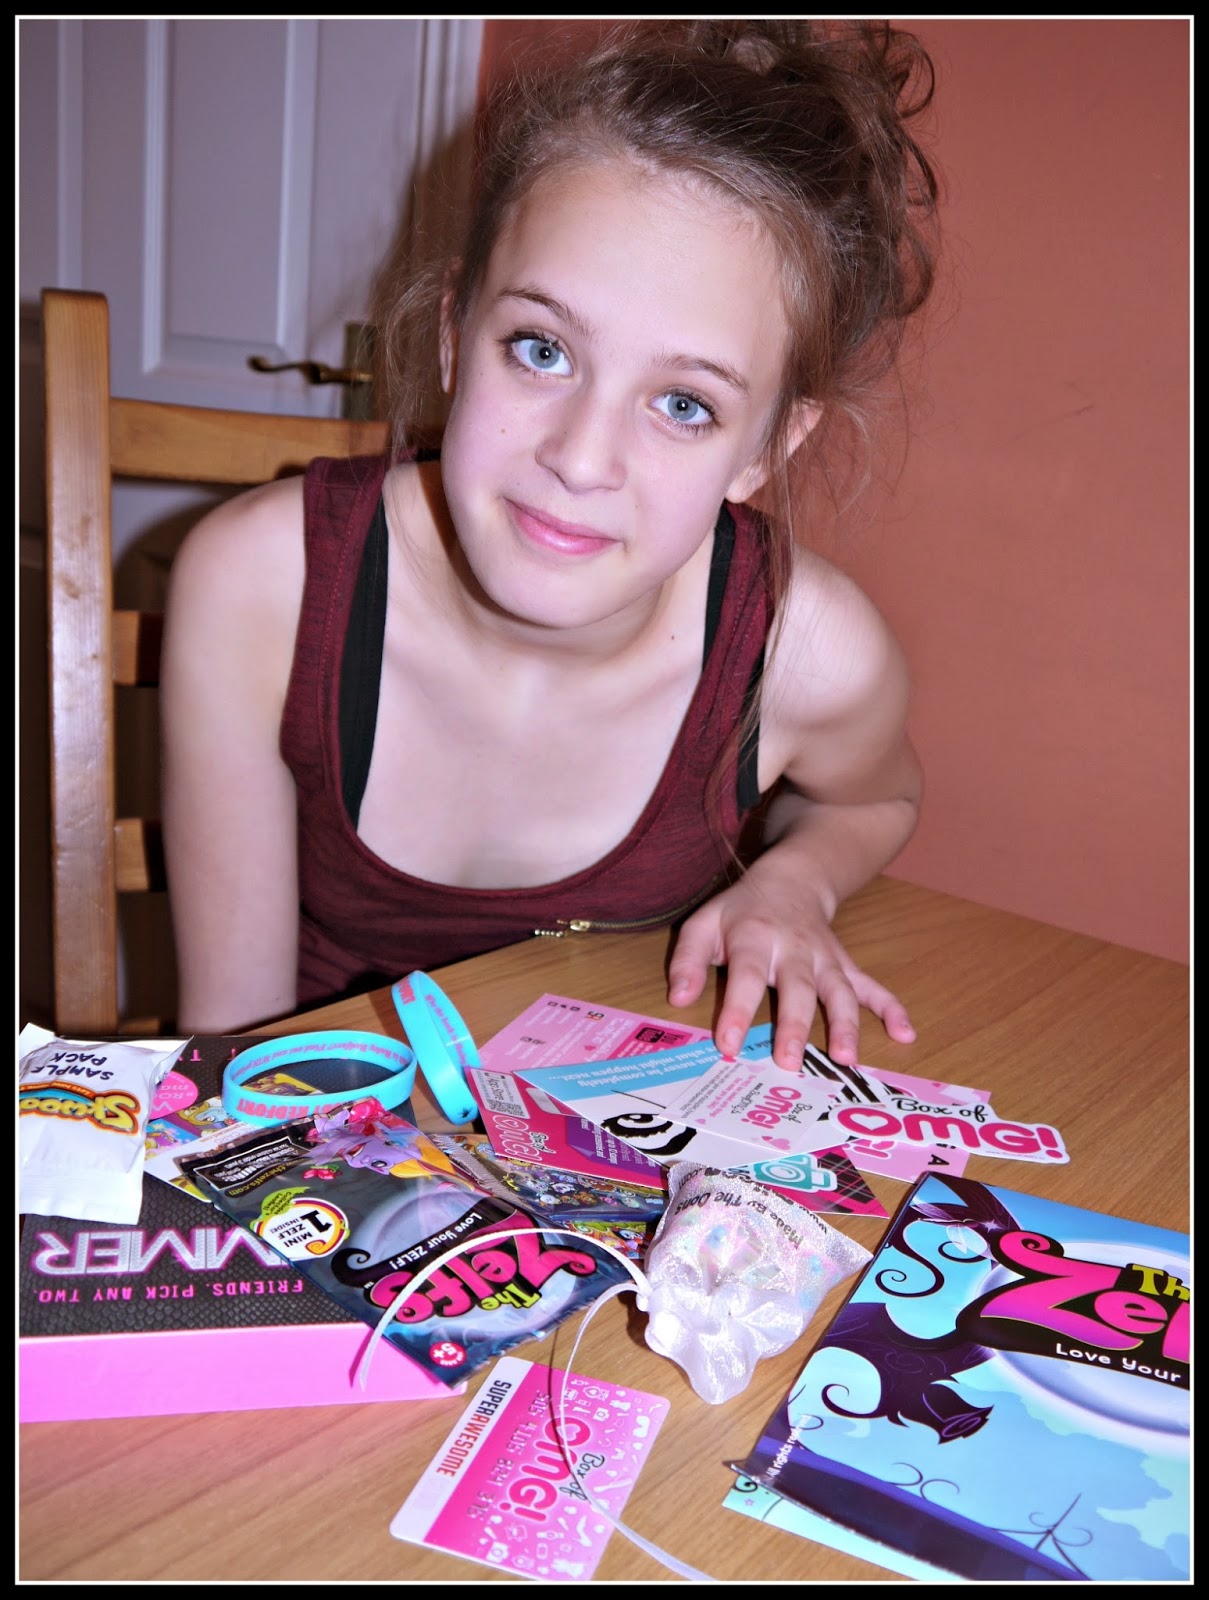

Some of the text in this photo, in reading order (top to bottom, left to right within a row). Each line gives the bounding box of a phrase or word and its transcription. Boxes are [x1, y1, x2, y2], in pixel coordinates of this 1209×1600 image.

[50, 1052, 107, 1066] PACK
[304, 1044, 326, 1052] Find
[675, 1049, 705, 1061] what
[592, 1061, 639, 1080] happen
[640, 1056, 676, 1069] might
[648, 1067, 664, 1077] be
[663, 1062, 695, 1074] never
[577, 1070, 646, 1088] completely
[741, 1086, 803, 1130] OMG!
[780, 1103, 813, 1124] Box of
[891, 1098, 989, 1123] Box of
[837, 1106, 1063, 1160] OMG!
[269, 1217, 299, 1234] INSIDE!
[300, 1210, 332, 1233] 1
[456, 1211, 483, 1233] Love
[674, 1190, 804, 1250] Made By The Dons
[278, 1223, 306, 1240] ZELF
[283, 1231, 313, 1248] MINI
[369, 1209, 597, 1323] Zelfs
[388, 1248, 428, 1270] ZELF!
[34, 1279, 304, 1303] FRIENDS. PICK ANY TWO.
[480, 1282, 541, 1311] The
[432, 1343, 459, 1360] 5+
[1055, 1342, 1112, 1365] Love
[436, 1379, 512, 1478] SUPERAWESOME
[772, 1443, 793, 1469] rights
[499, 1416, 592, 1523] OMG!
[558, 1452, 606, 1501] Box of
